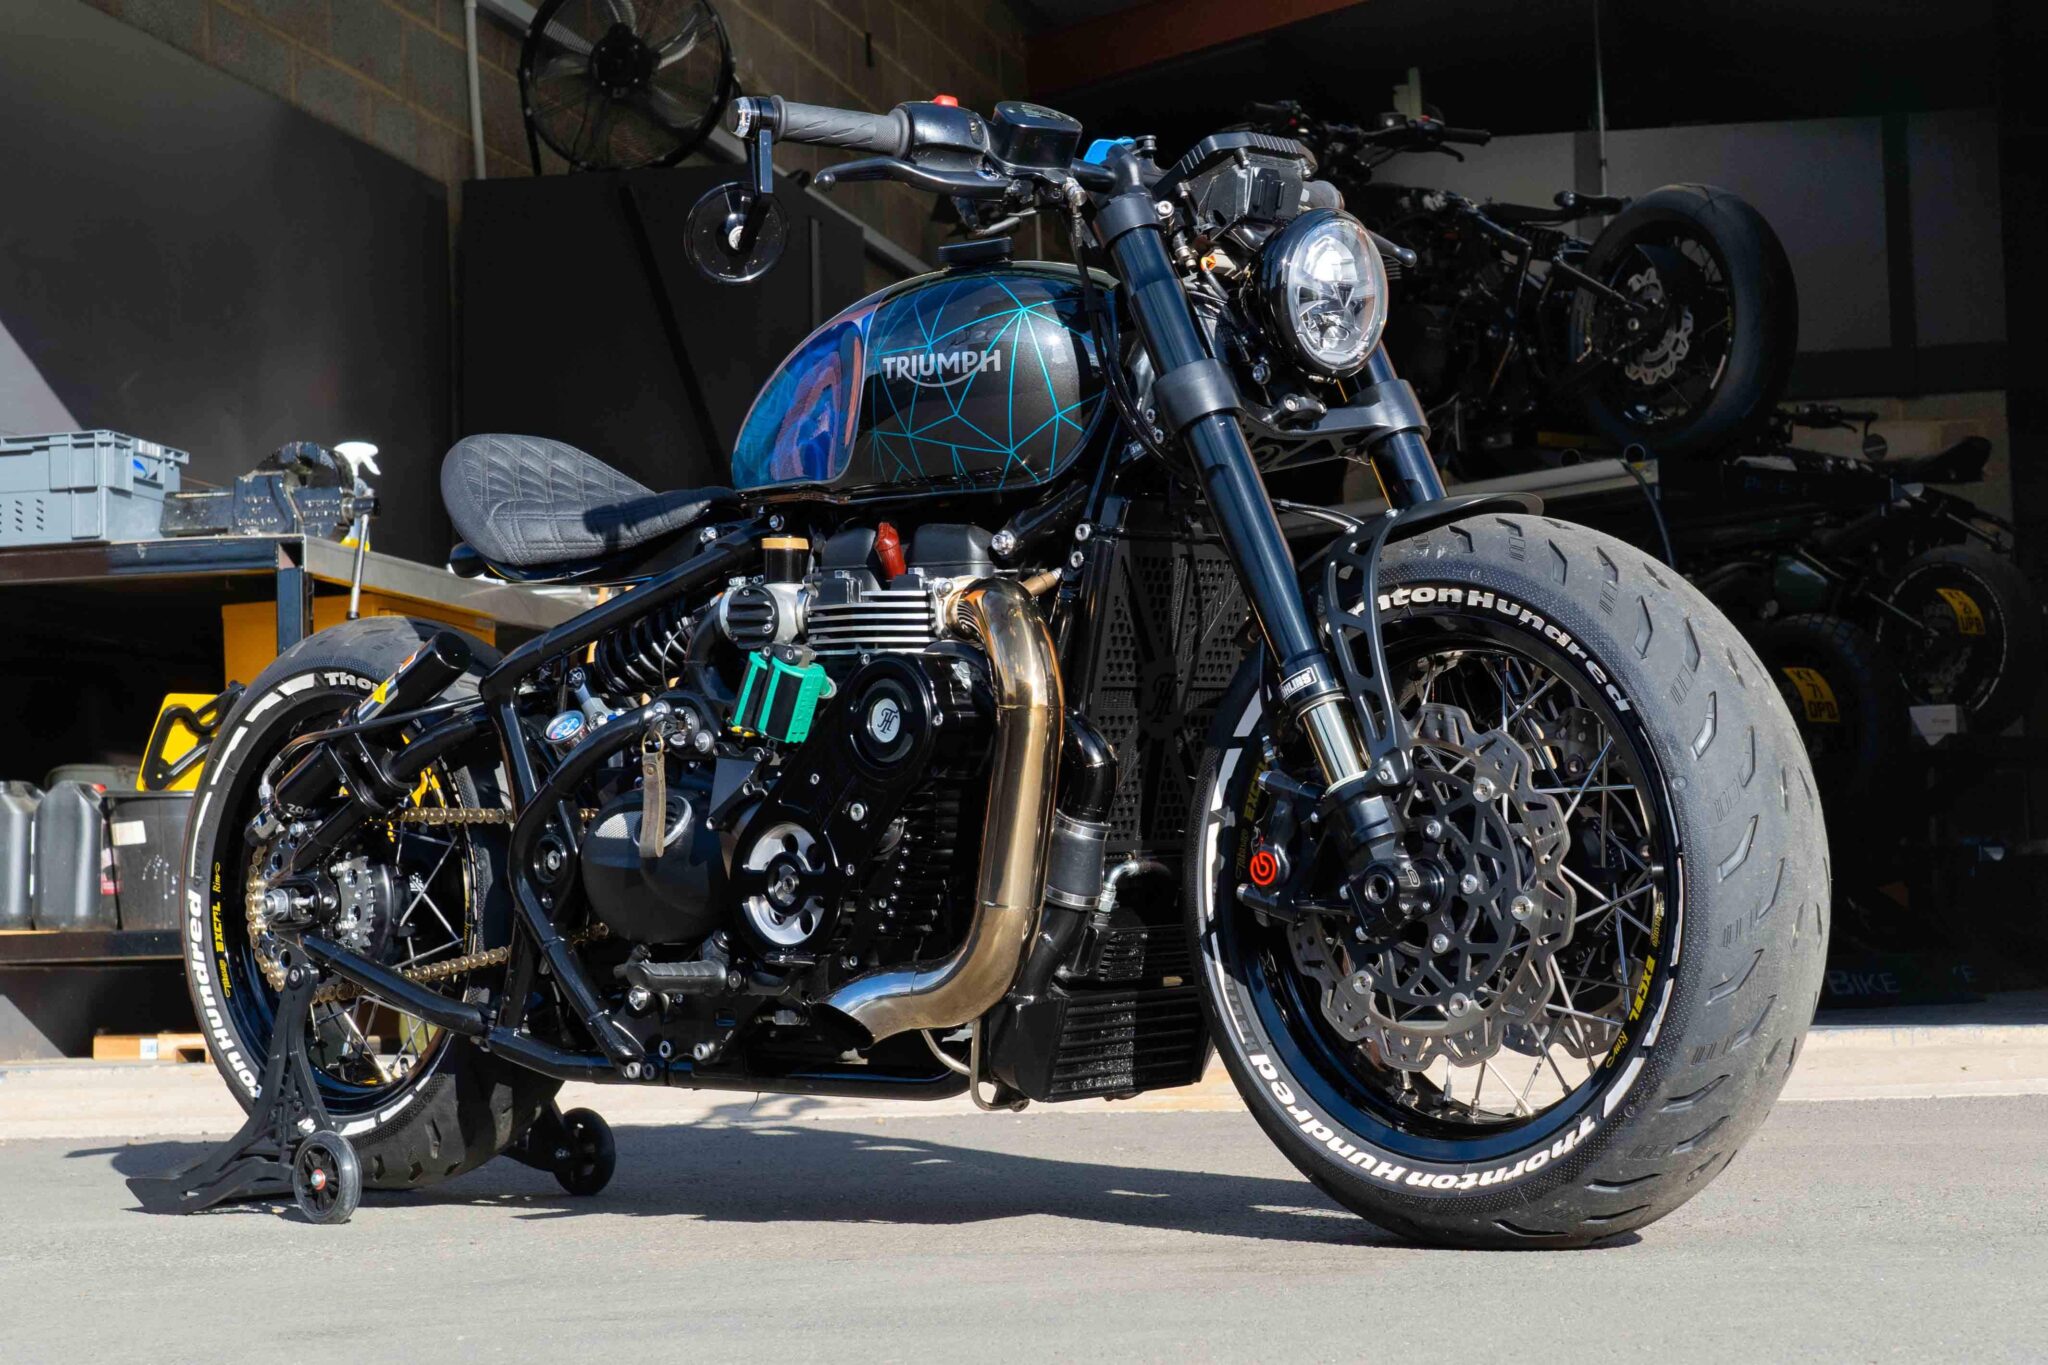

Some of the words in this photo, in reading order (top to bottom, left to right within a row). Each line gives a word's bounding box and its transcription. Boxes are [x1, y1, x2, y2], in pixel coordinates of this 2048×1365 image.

[883, 349, 1001, 387] TRIUMPH
[1466, 589, 1631, 712] Hundred
[188, 889, 235, 1050] Hundred
[1628, 954, 1656, 1021] EXCEL
[1249, 1054, 1407, 1182] Hundred
[1405, 1115, 1597, 1190] Thornton
